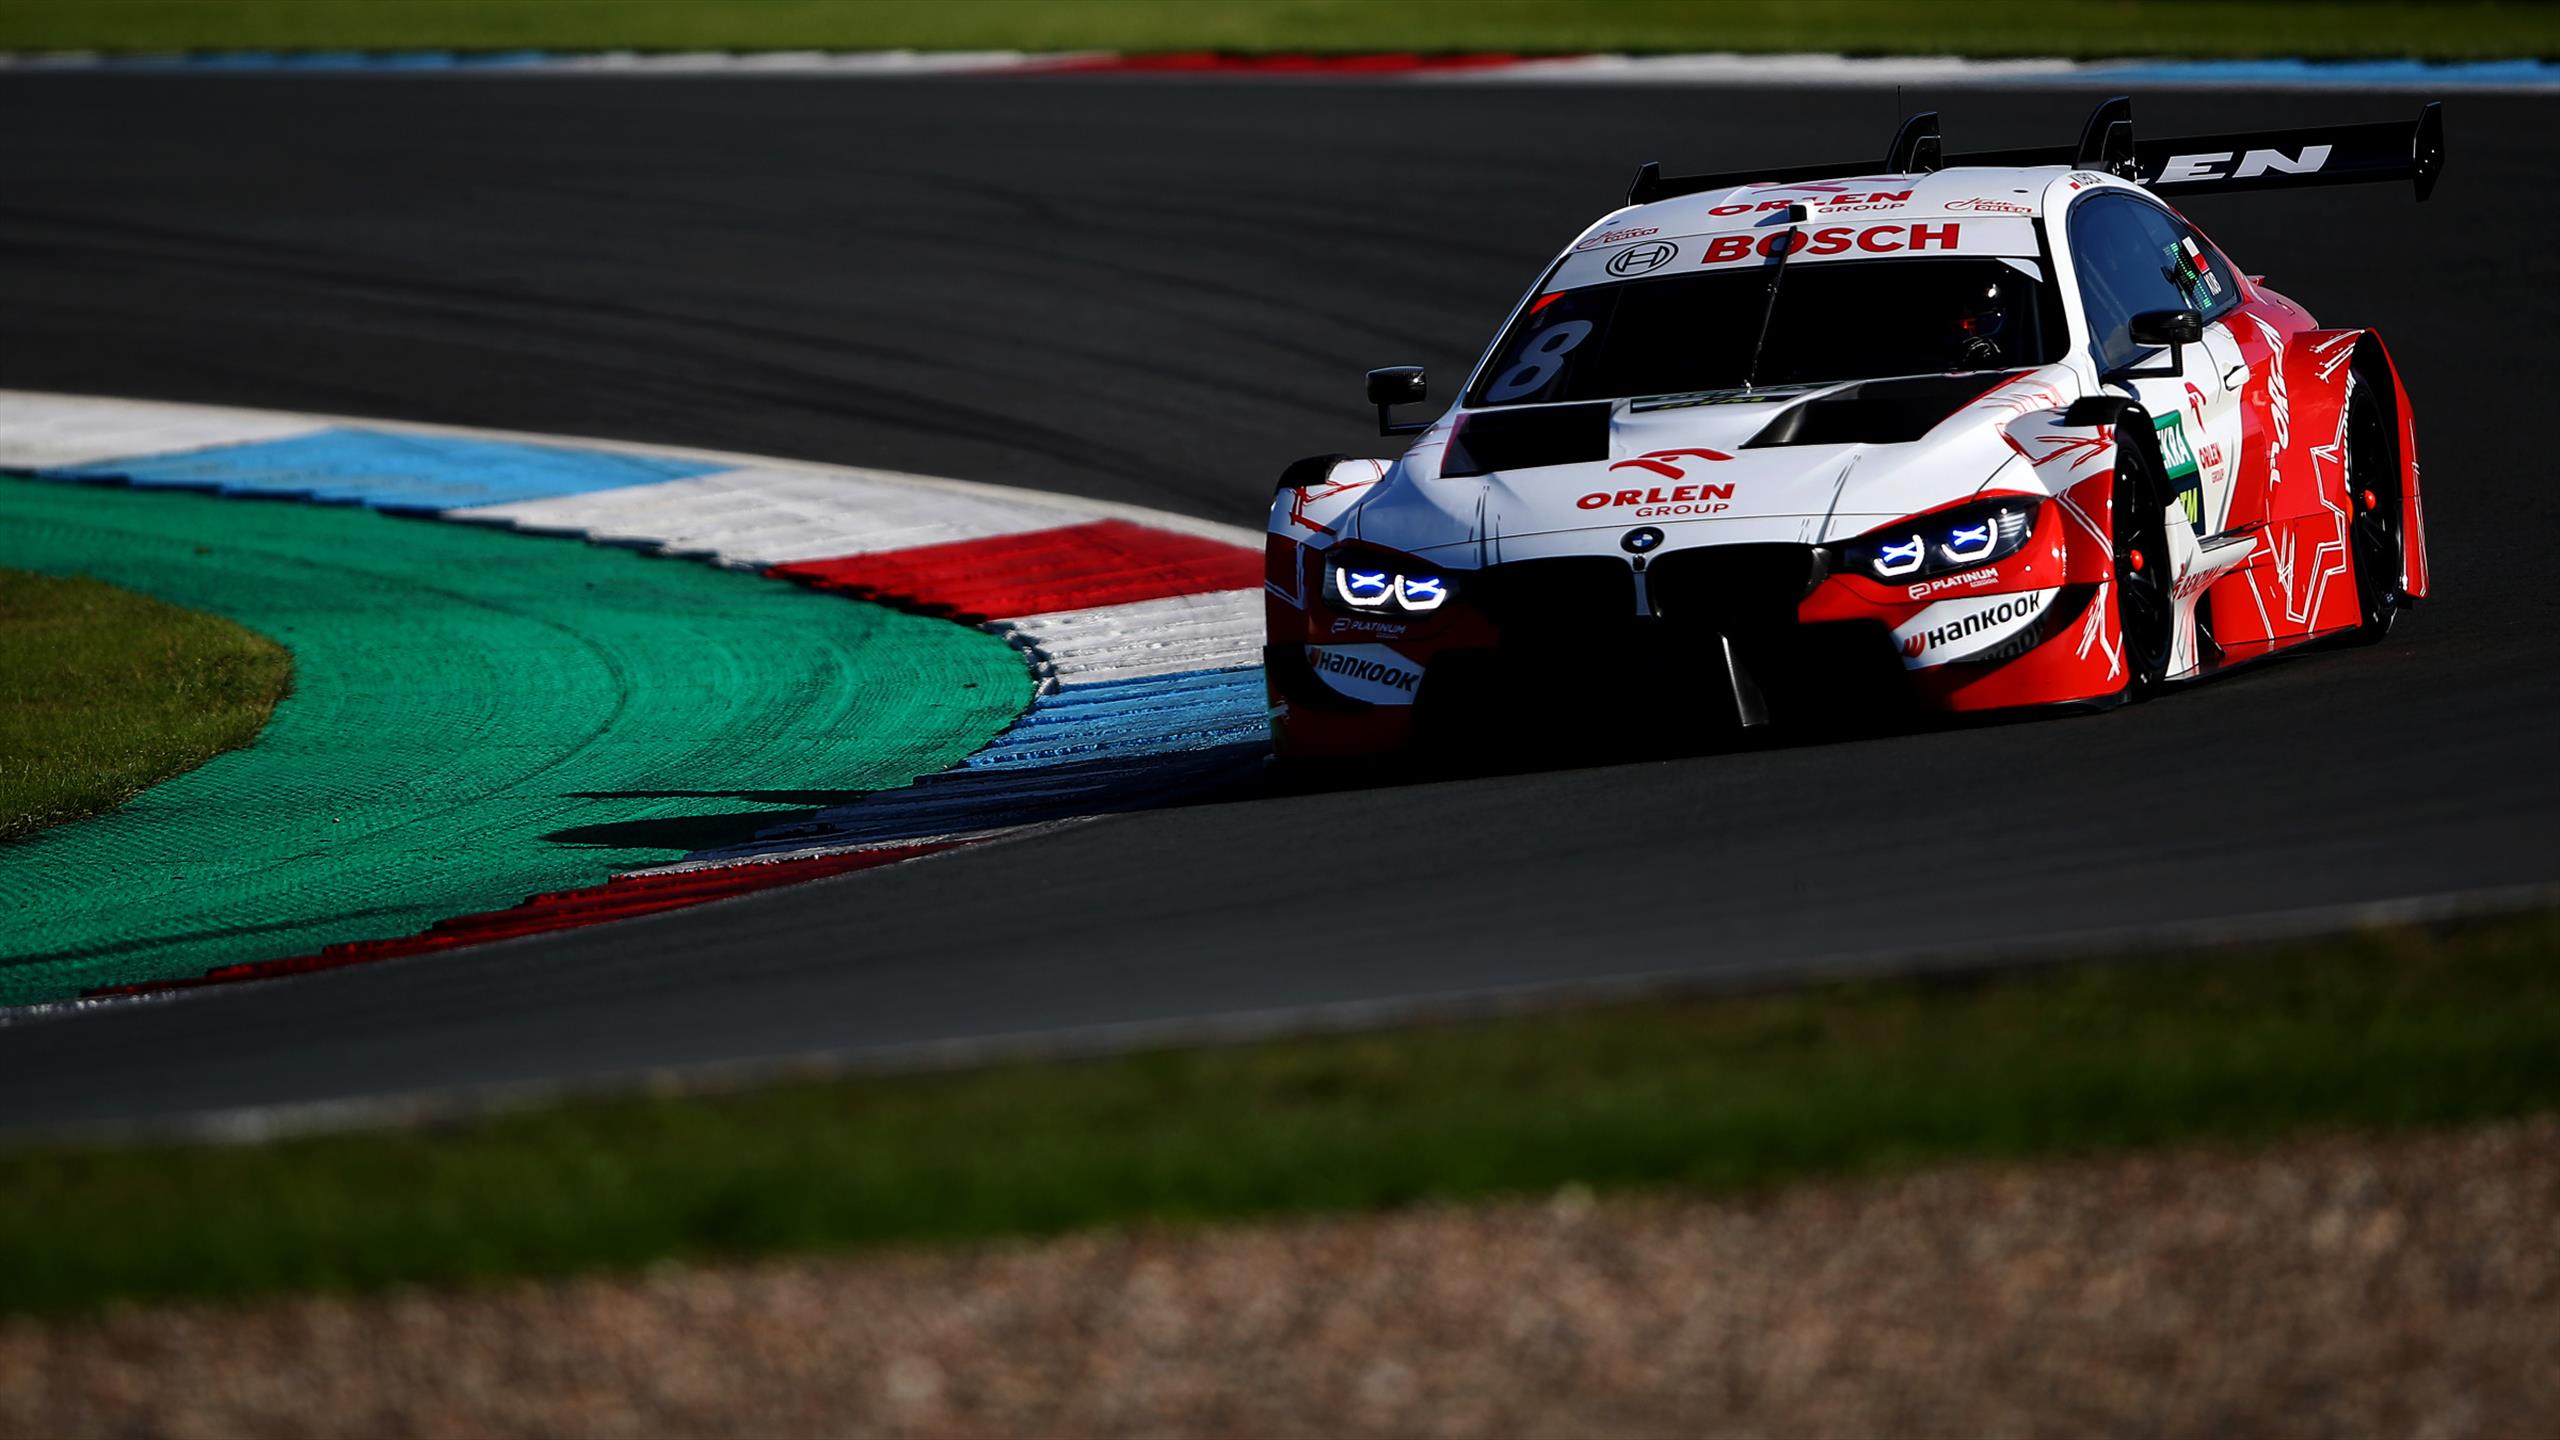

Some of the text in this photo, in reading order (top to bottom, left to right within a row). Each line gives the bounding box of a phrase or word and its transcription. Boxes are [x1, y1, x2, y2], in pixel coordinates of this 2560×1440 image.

[2136, 145, 2333, 185] EN
[1818, 203, 1905, 214] GROUP
[1701, 223, 1961, 264] BOSCH
[1485, 319, 1594, 402] 8
[2155, 423, 2192, 470] KRA
[1576, 483, 1736, 510] ORLEN
[1635, 503, 1729, 518] GROUP
[2179, 487, 2198, 525] TM
[1931, 567, 1999, 591] PLATINUM
